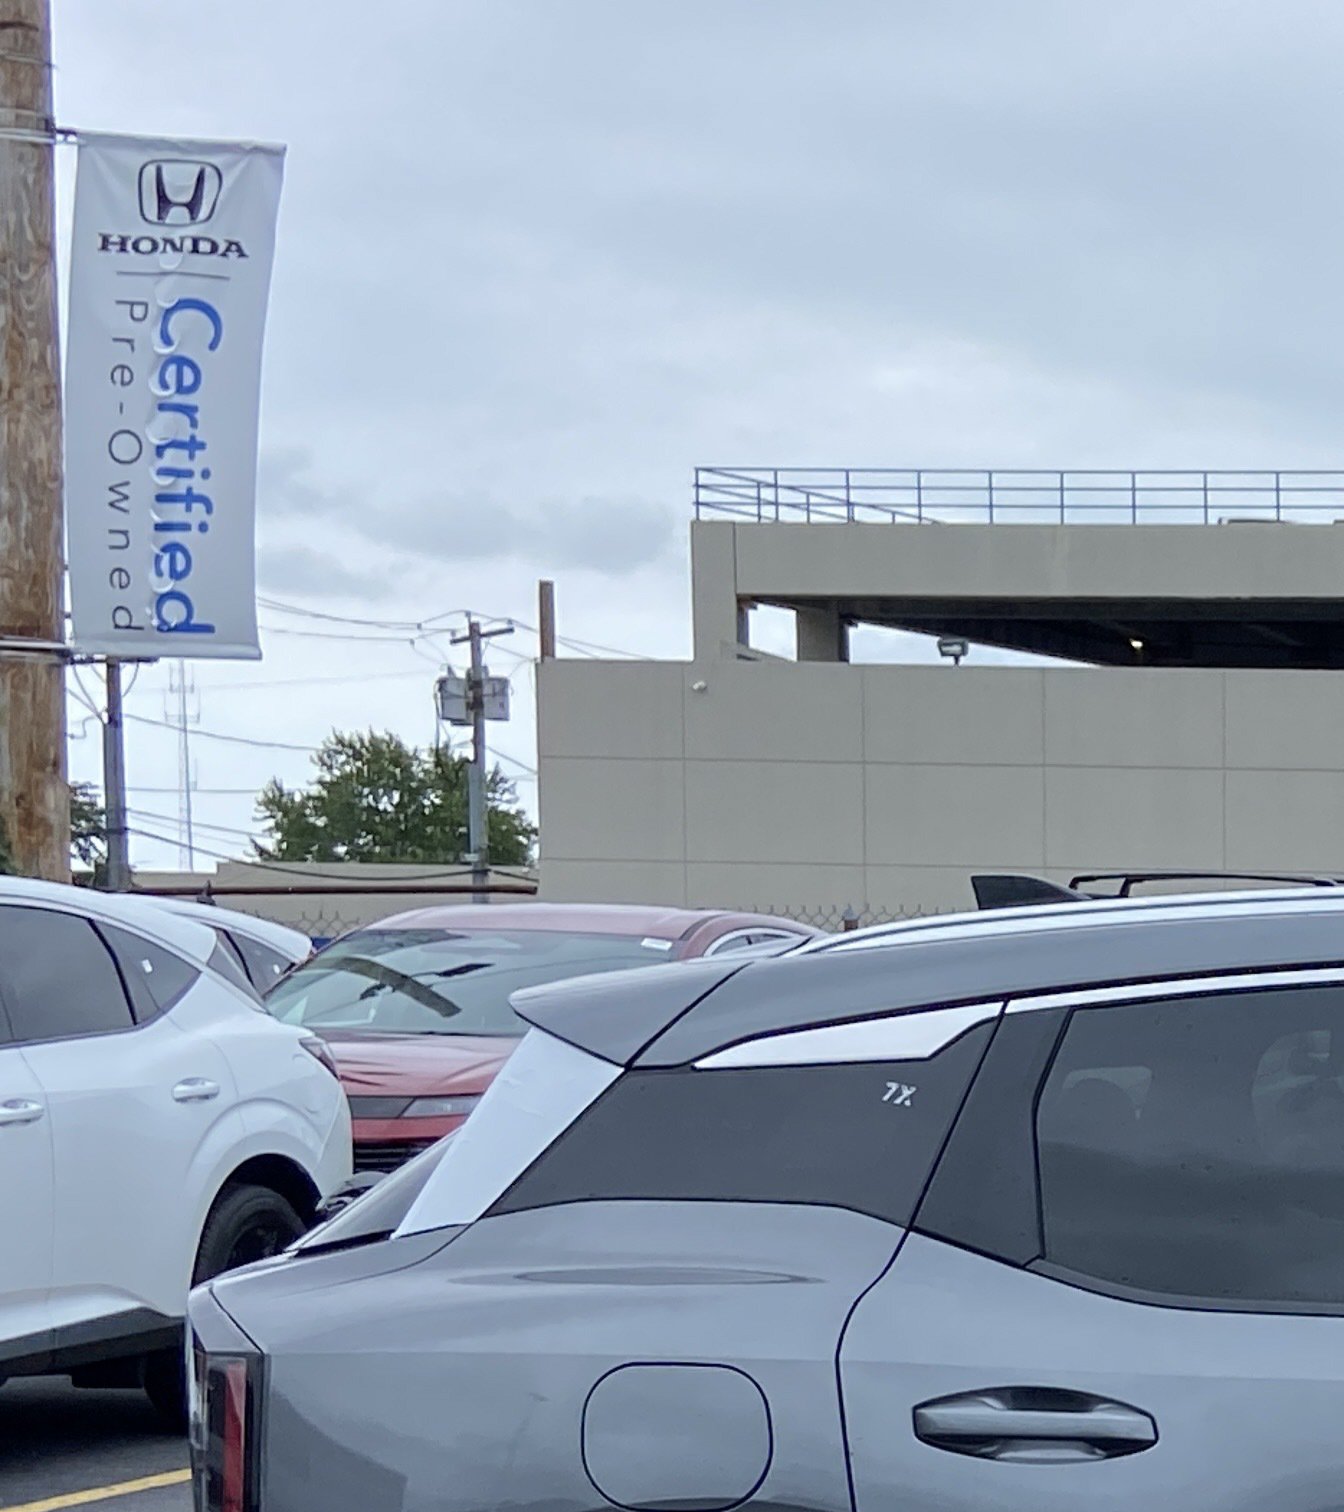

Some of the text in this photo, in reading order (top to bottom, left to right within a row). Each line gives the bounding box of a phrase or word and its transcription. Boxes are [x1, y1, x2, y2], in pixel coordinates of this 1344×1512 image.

[98, 233, 249, 258] HONDA
[108, 300, 149, 631] Pre-Owned
[153, 298, 223, 634] Certified
